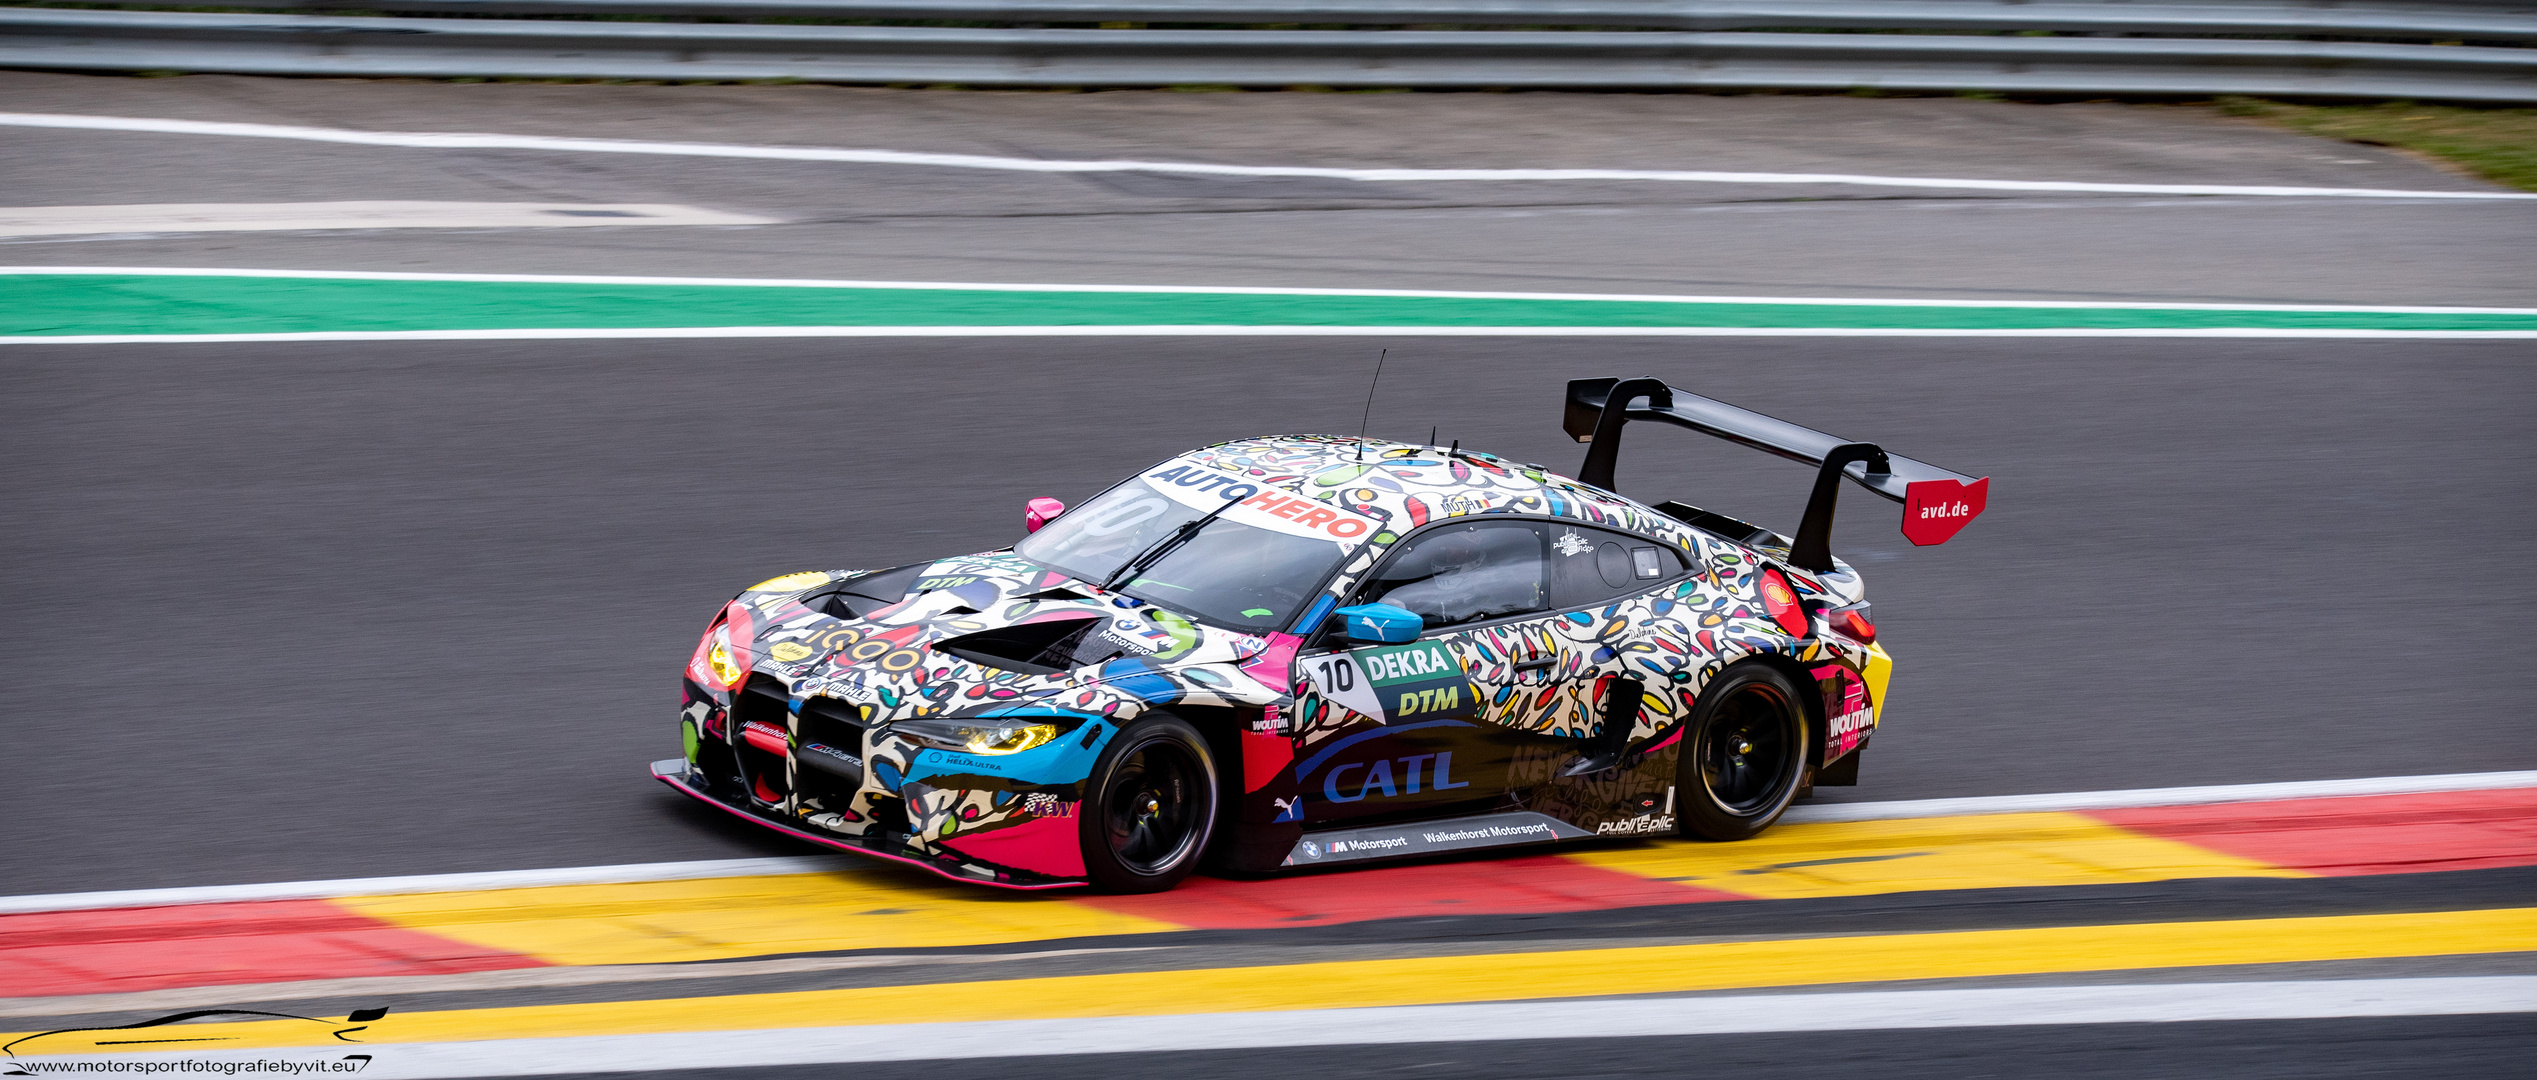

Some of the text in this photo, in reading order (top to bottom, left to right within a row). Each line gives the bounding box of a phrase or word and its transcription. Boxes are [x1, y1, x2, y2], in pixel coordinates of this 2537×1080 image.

[1441, 500, 1477, 513] MUTH
[1920, 502, 1969, 519] avd.de
[916, 576, 978, 590] DTM
[760, 659, 798, 677] MAHLE
[1365, 646, 1450, 681] DEKRA
[1318, 659, 1354, 694] 10
[827, 681, 872, 701] MAHLE
[1398, 686, 1459, 717] DTM
[1828, 728, 1873, 749] TOTAL INTERIORS
[1323, 750, 1469, 803] CATL
[1032, 801, 1075, 818] KW
[1423, 822, 1550, 844] Walkenhorst Motorsport
[1349, 836, 1408, 851] Motorsport
